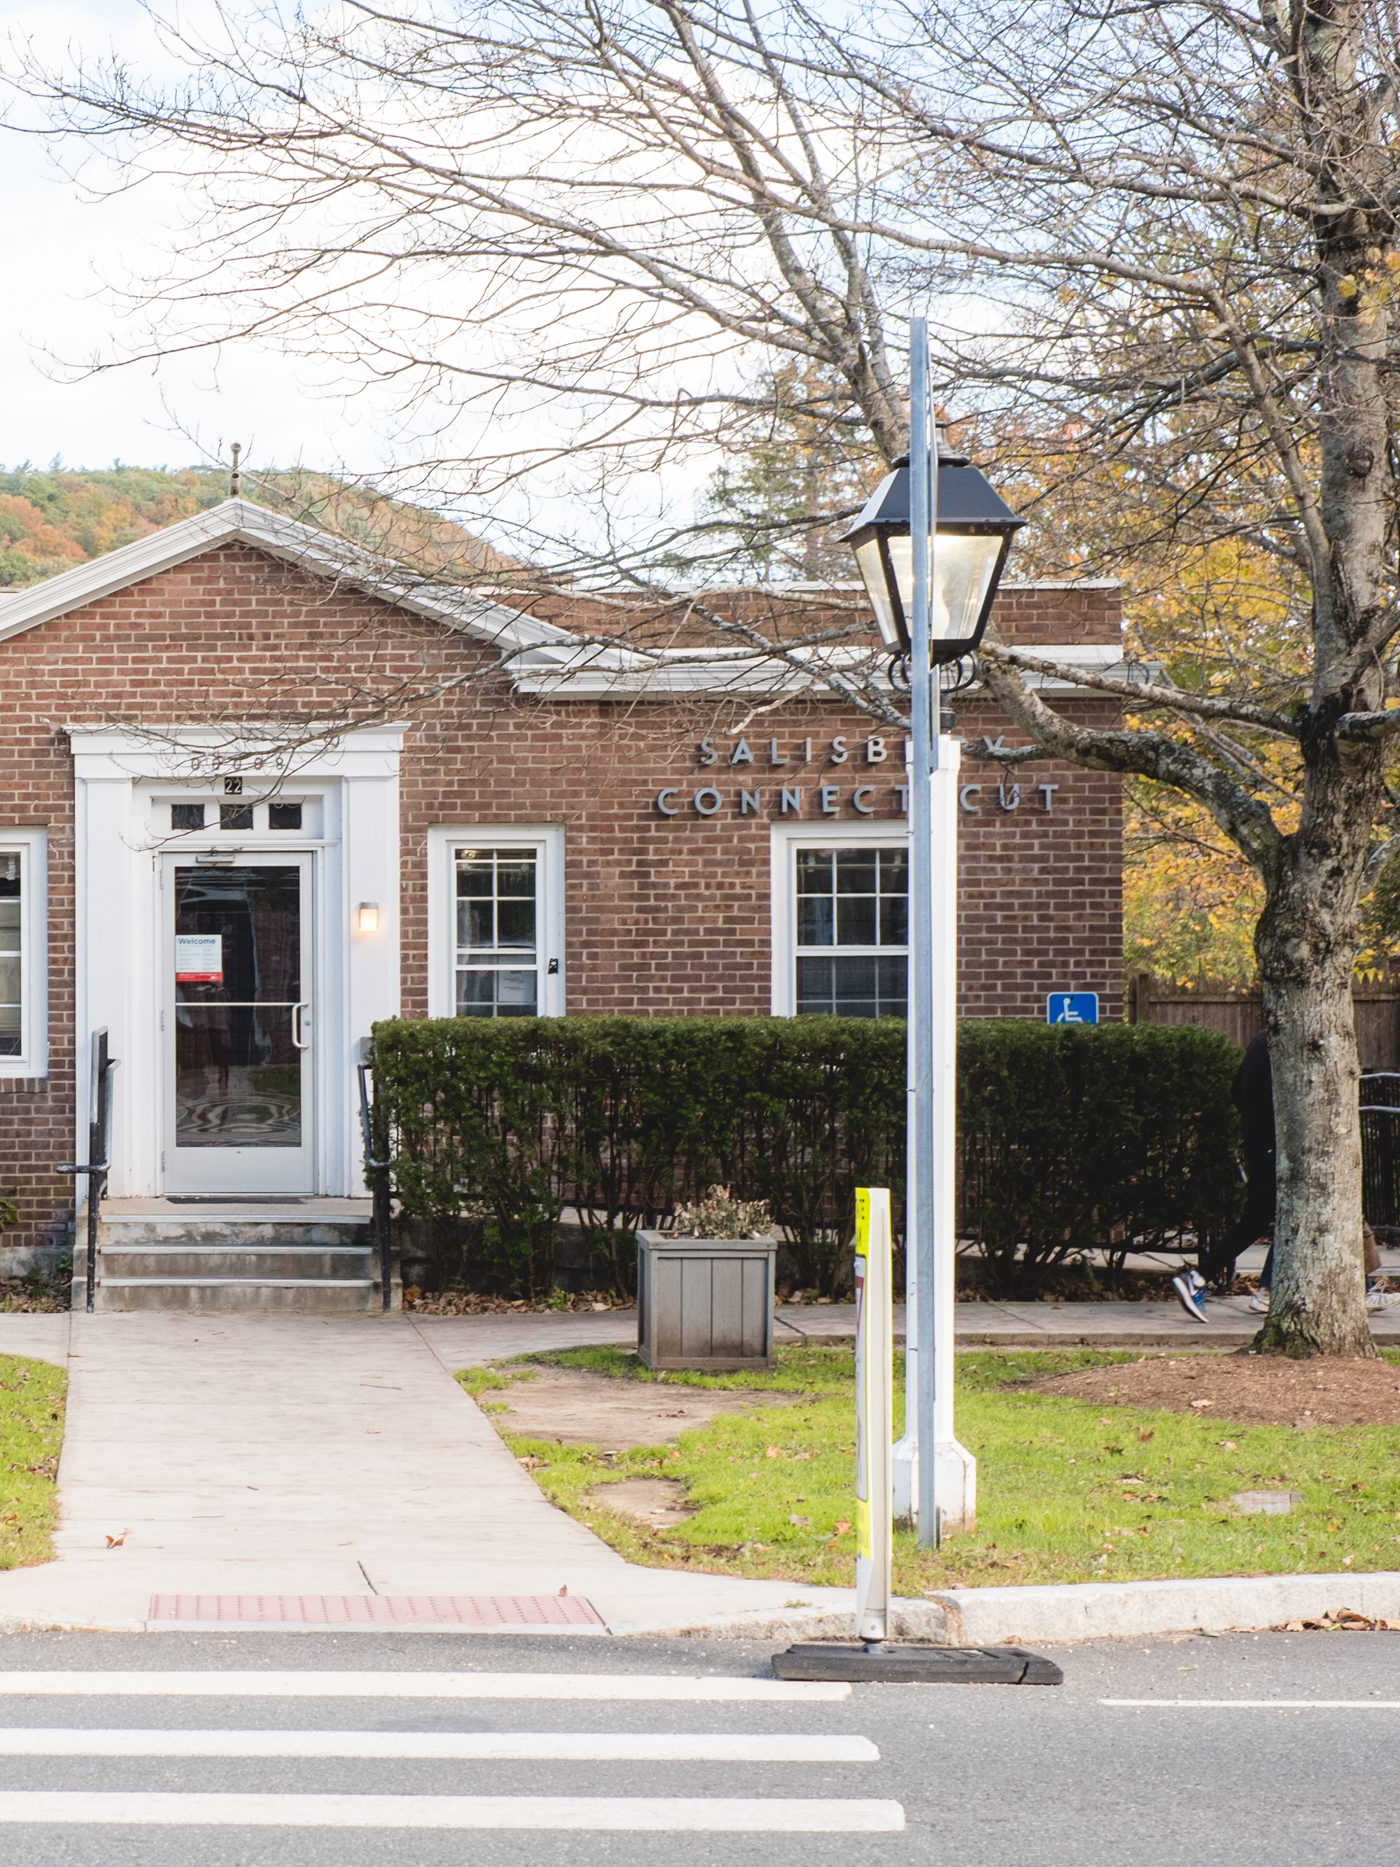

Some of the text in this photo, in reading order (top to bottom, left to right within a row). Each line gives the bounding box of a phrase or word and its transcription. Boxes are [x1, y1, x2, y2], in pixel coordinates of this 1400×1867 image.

[700, 735, 1005, 765] SALISBY
[225, 779, 242, 793] 22
[657, 784, 1059, 816] CONNECTCUT
